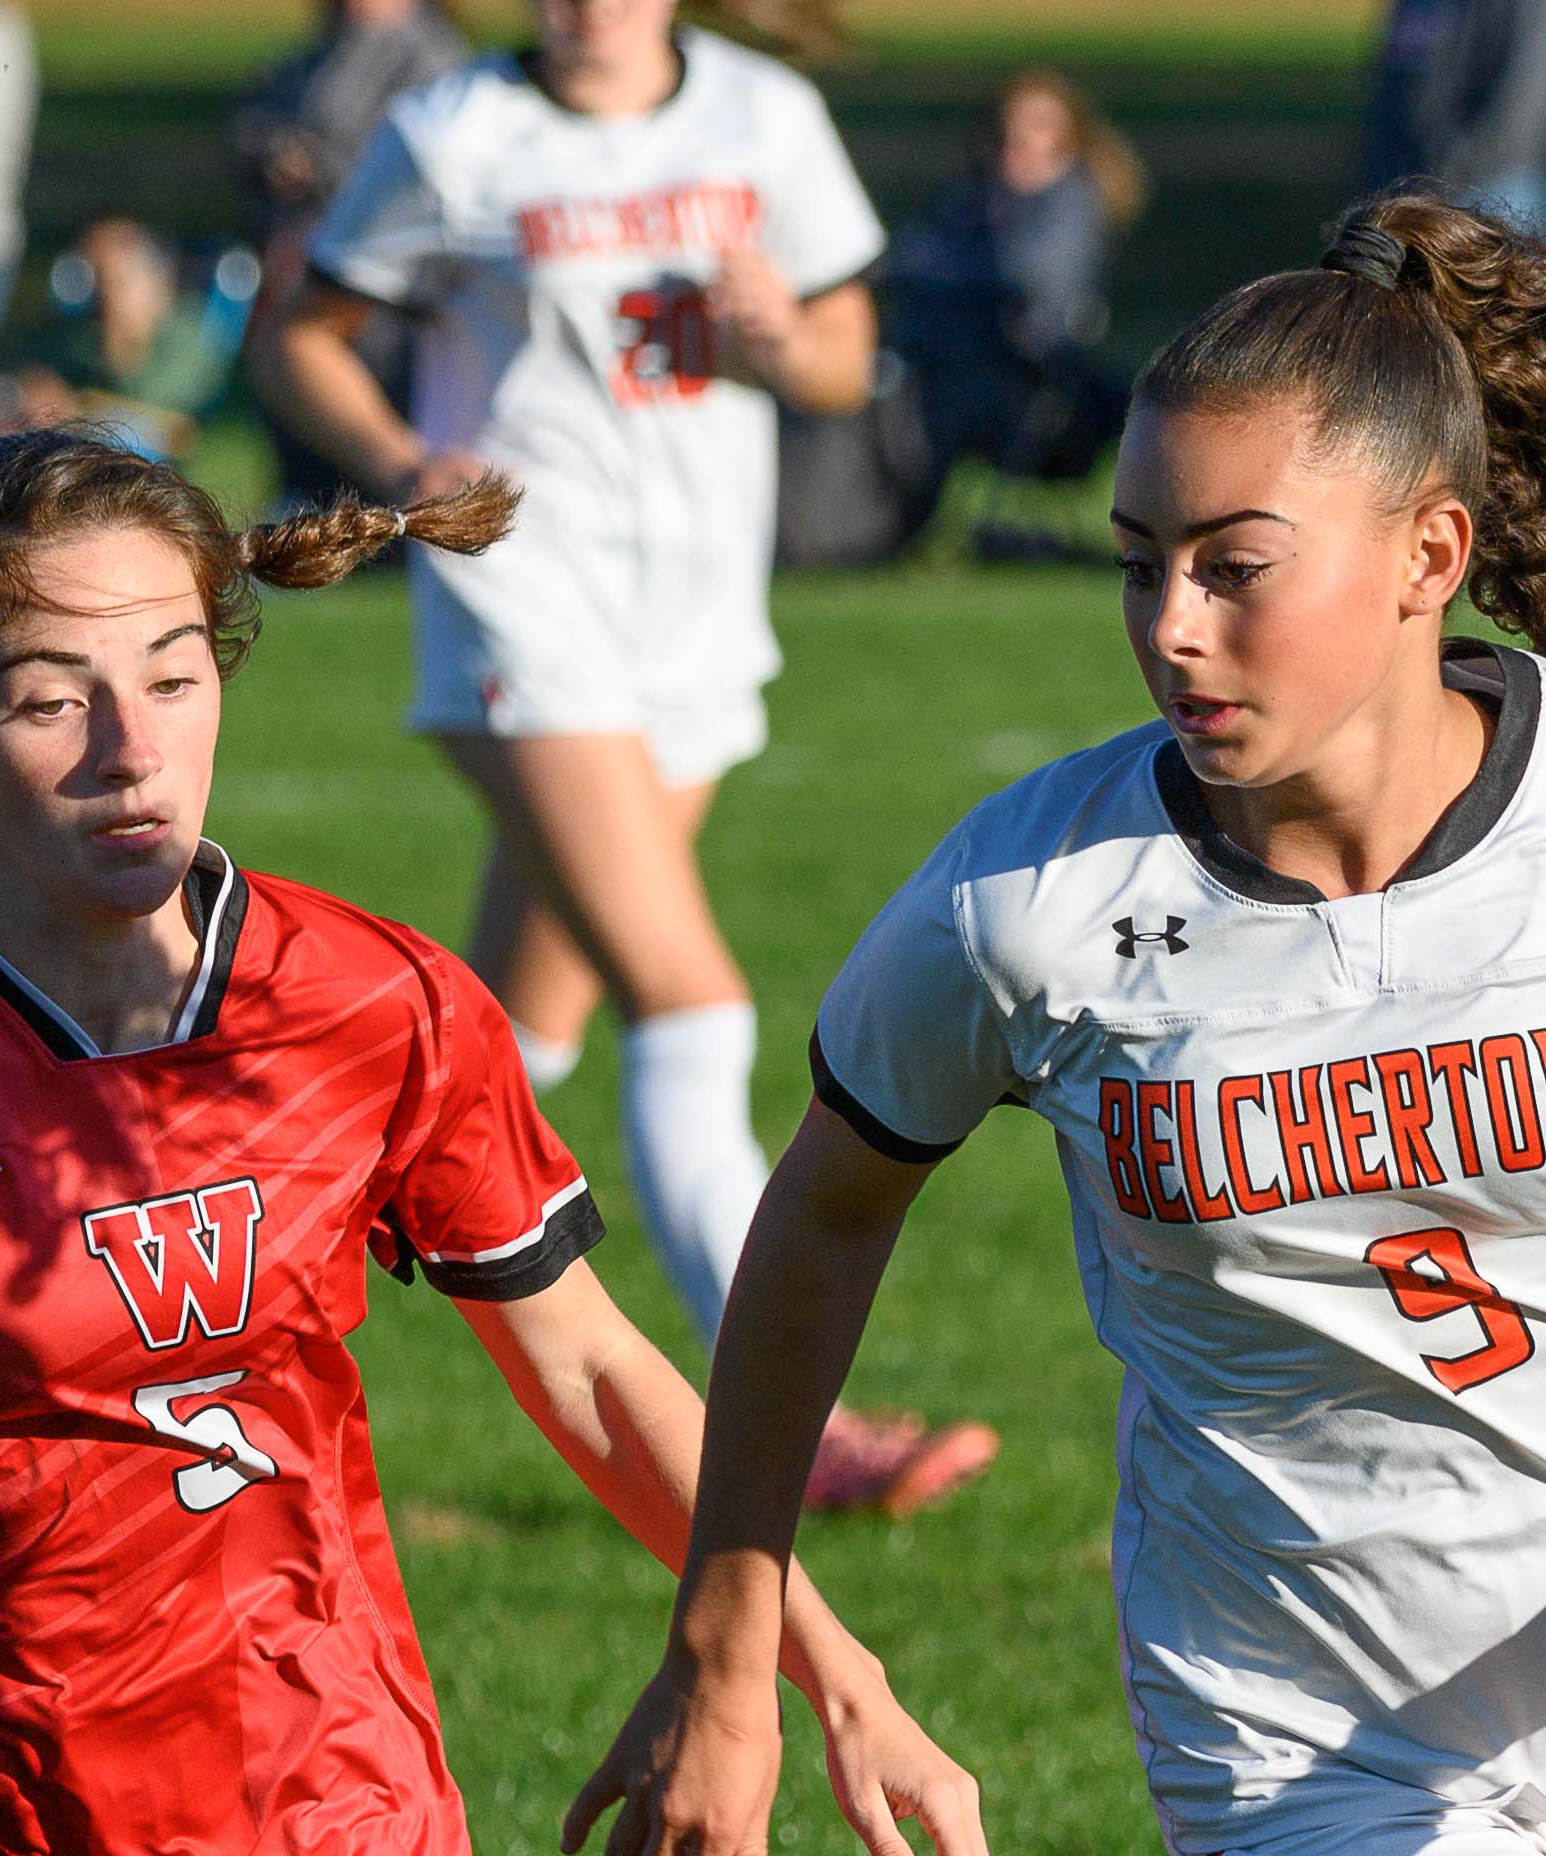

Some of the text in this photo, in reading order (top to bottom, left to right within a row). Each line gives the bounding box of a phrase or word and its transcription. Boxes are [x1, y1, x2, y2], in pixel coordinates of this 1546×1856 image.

[80, 1175, 265, 1351] W
[1362, 1226, 1537, 1397] 9
[132, 1369, 280, 1514] 5
